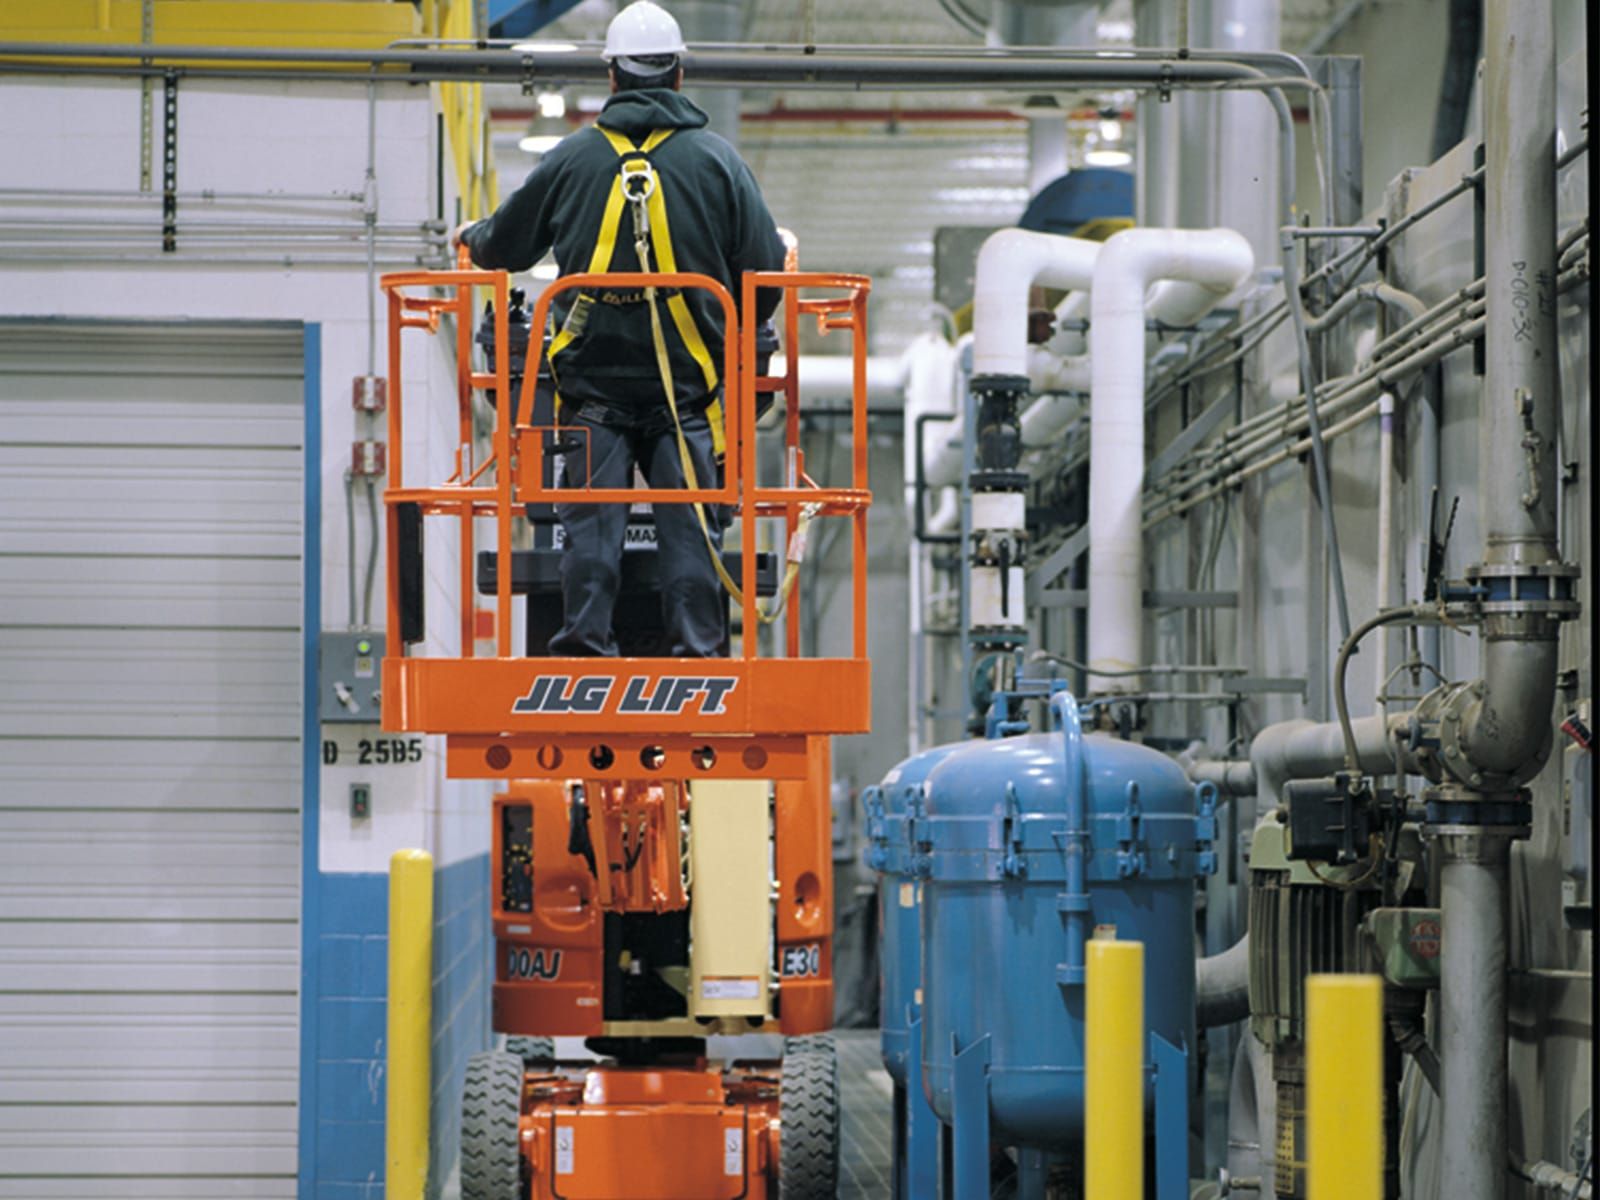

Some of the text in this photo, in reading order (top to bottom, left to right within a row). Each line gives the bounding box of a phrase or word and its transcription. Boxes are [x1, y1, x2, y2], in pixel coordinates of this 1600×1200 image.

[511, 675, 739, 715] JLG LIFT
[323, 739, 422, 765] D 25B5
